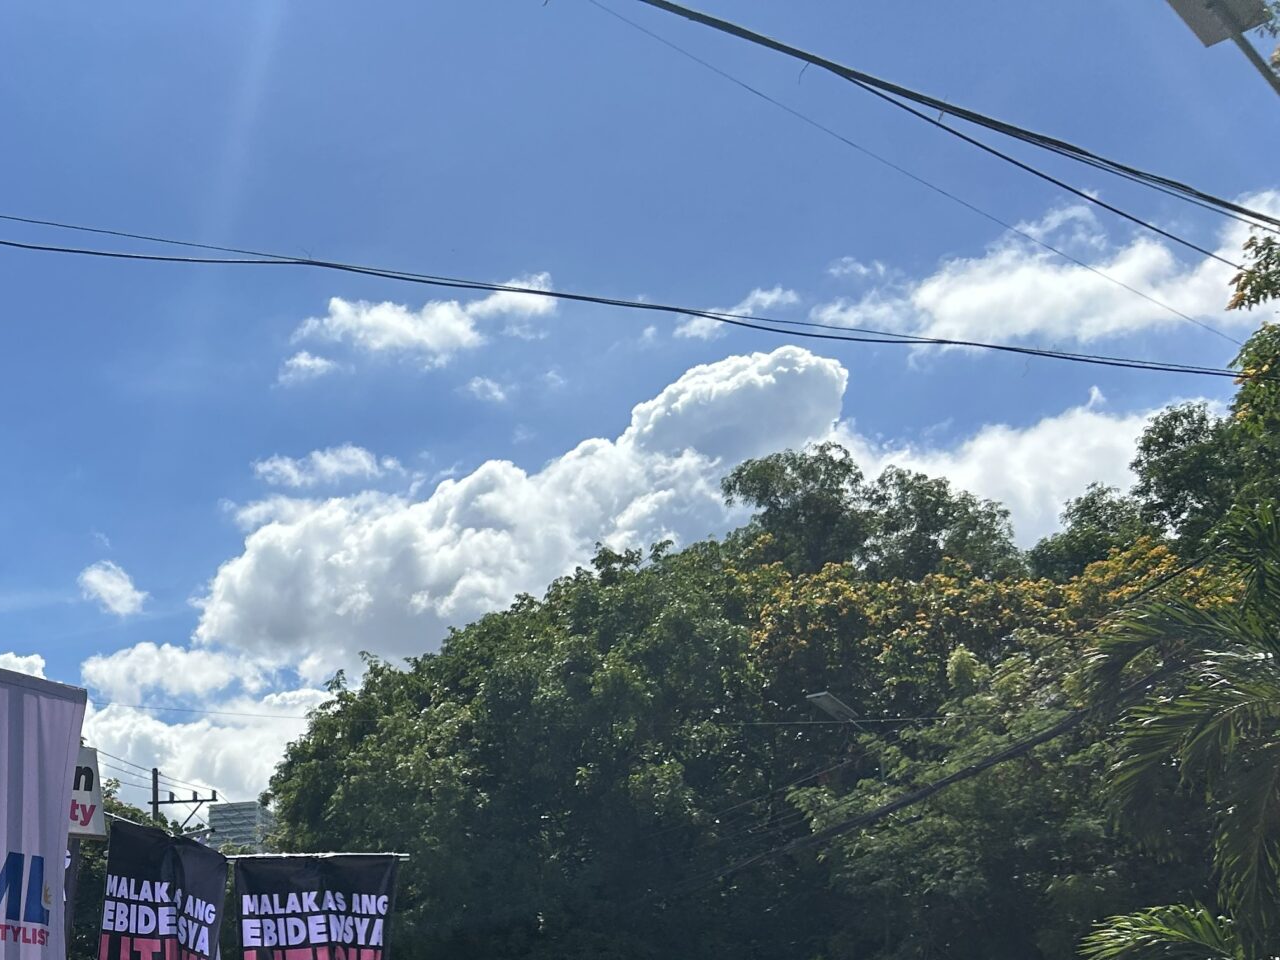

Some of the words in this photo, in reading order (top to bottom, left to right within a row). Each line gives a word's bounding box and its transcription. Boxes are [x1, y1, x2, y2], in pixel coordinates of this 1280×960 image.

[184, 894, 216, 925] ANG
[242, 890, 348, 916] MALAKAS
[352, 893, 389, 916] ANG
[102, 900, 210, 957] EBIDESYA
[242, 914, 384, 947] EBIDENSYA
